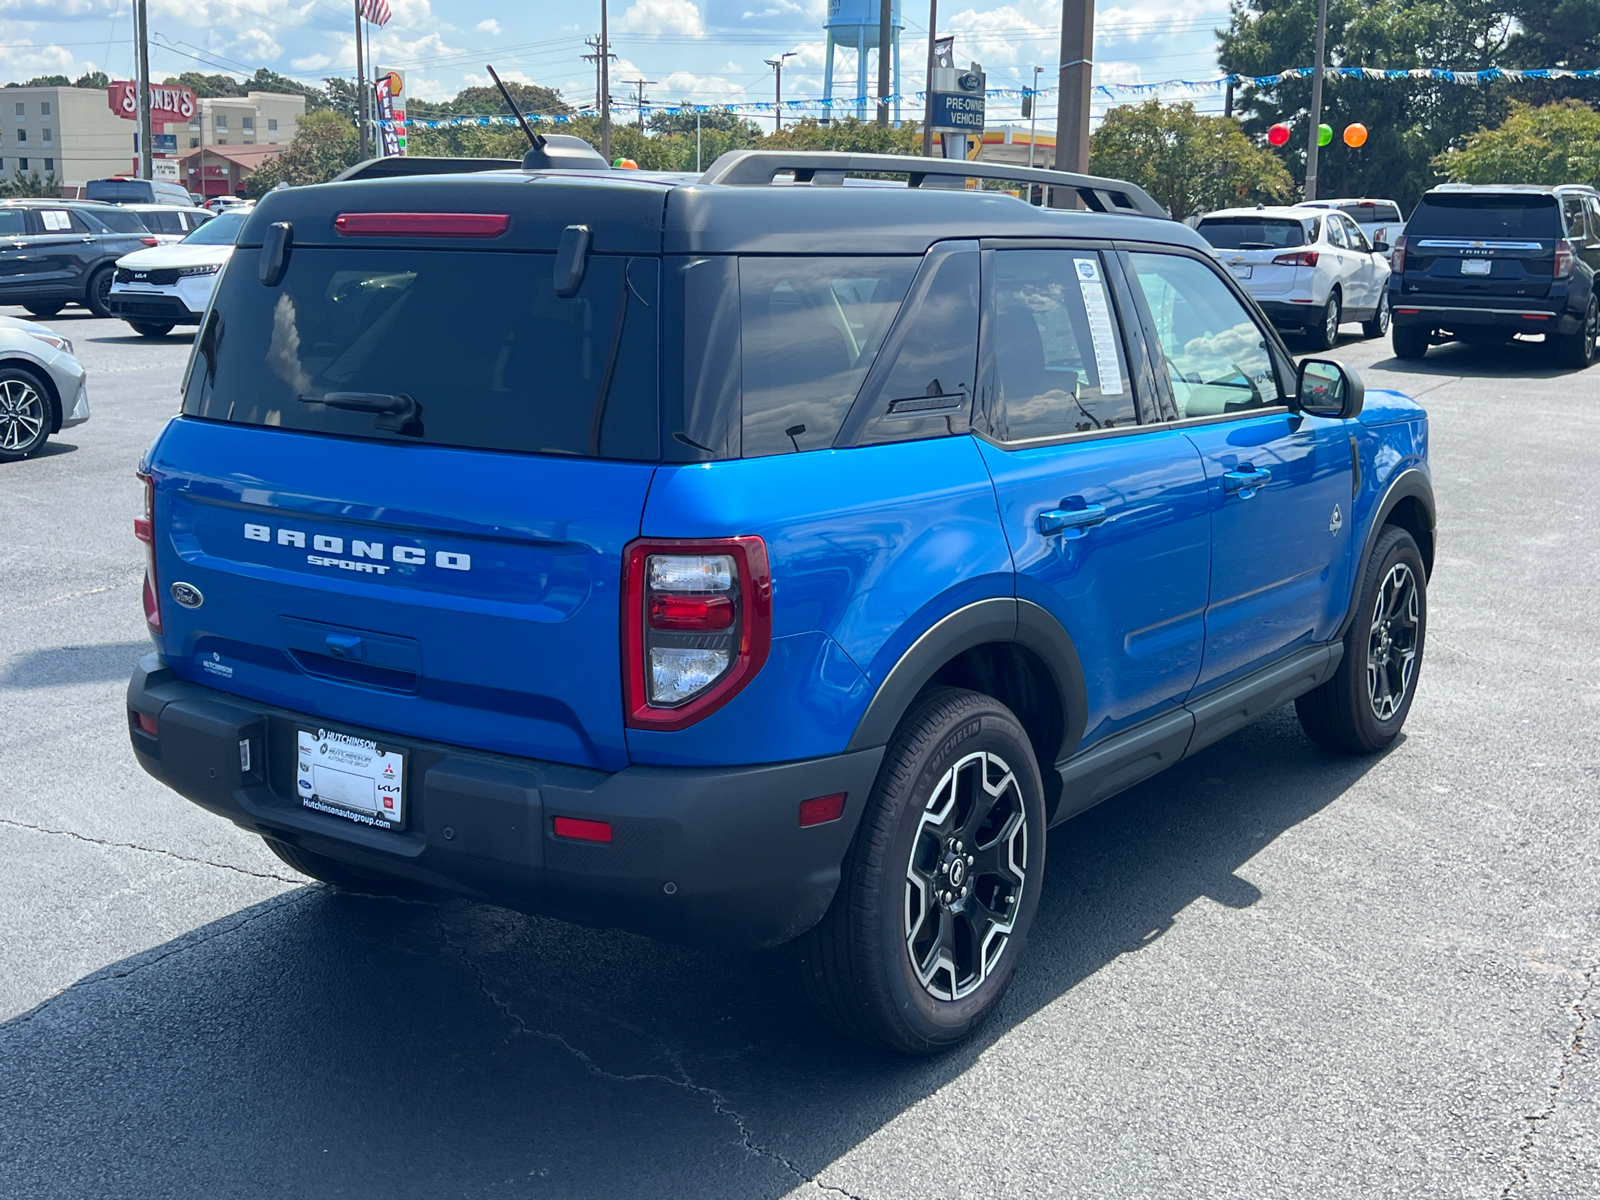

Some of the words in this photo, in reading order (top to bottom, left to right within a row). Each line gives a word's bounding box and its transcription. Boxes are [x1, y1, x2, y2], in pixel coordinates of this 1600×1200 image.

[951, 112, 983, 126] VEHICLES
[244, 523, 471, 571] BRONCO
[307, 555, 390, 575] SPORT
[175, 586, 194, 604] Ford
[326, 731, 377, 750] HUTCHINSON
[931, 721, 980, 773] MICHELIN
[378, 784, 400, 793] KIA
[303, 798, 391, 829] Hutchinsonautogroup.com
